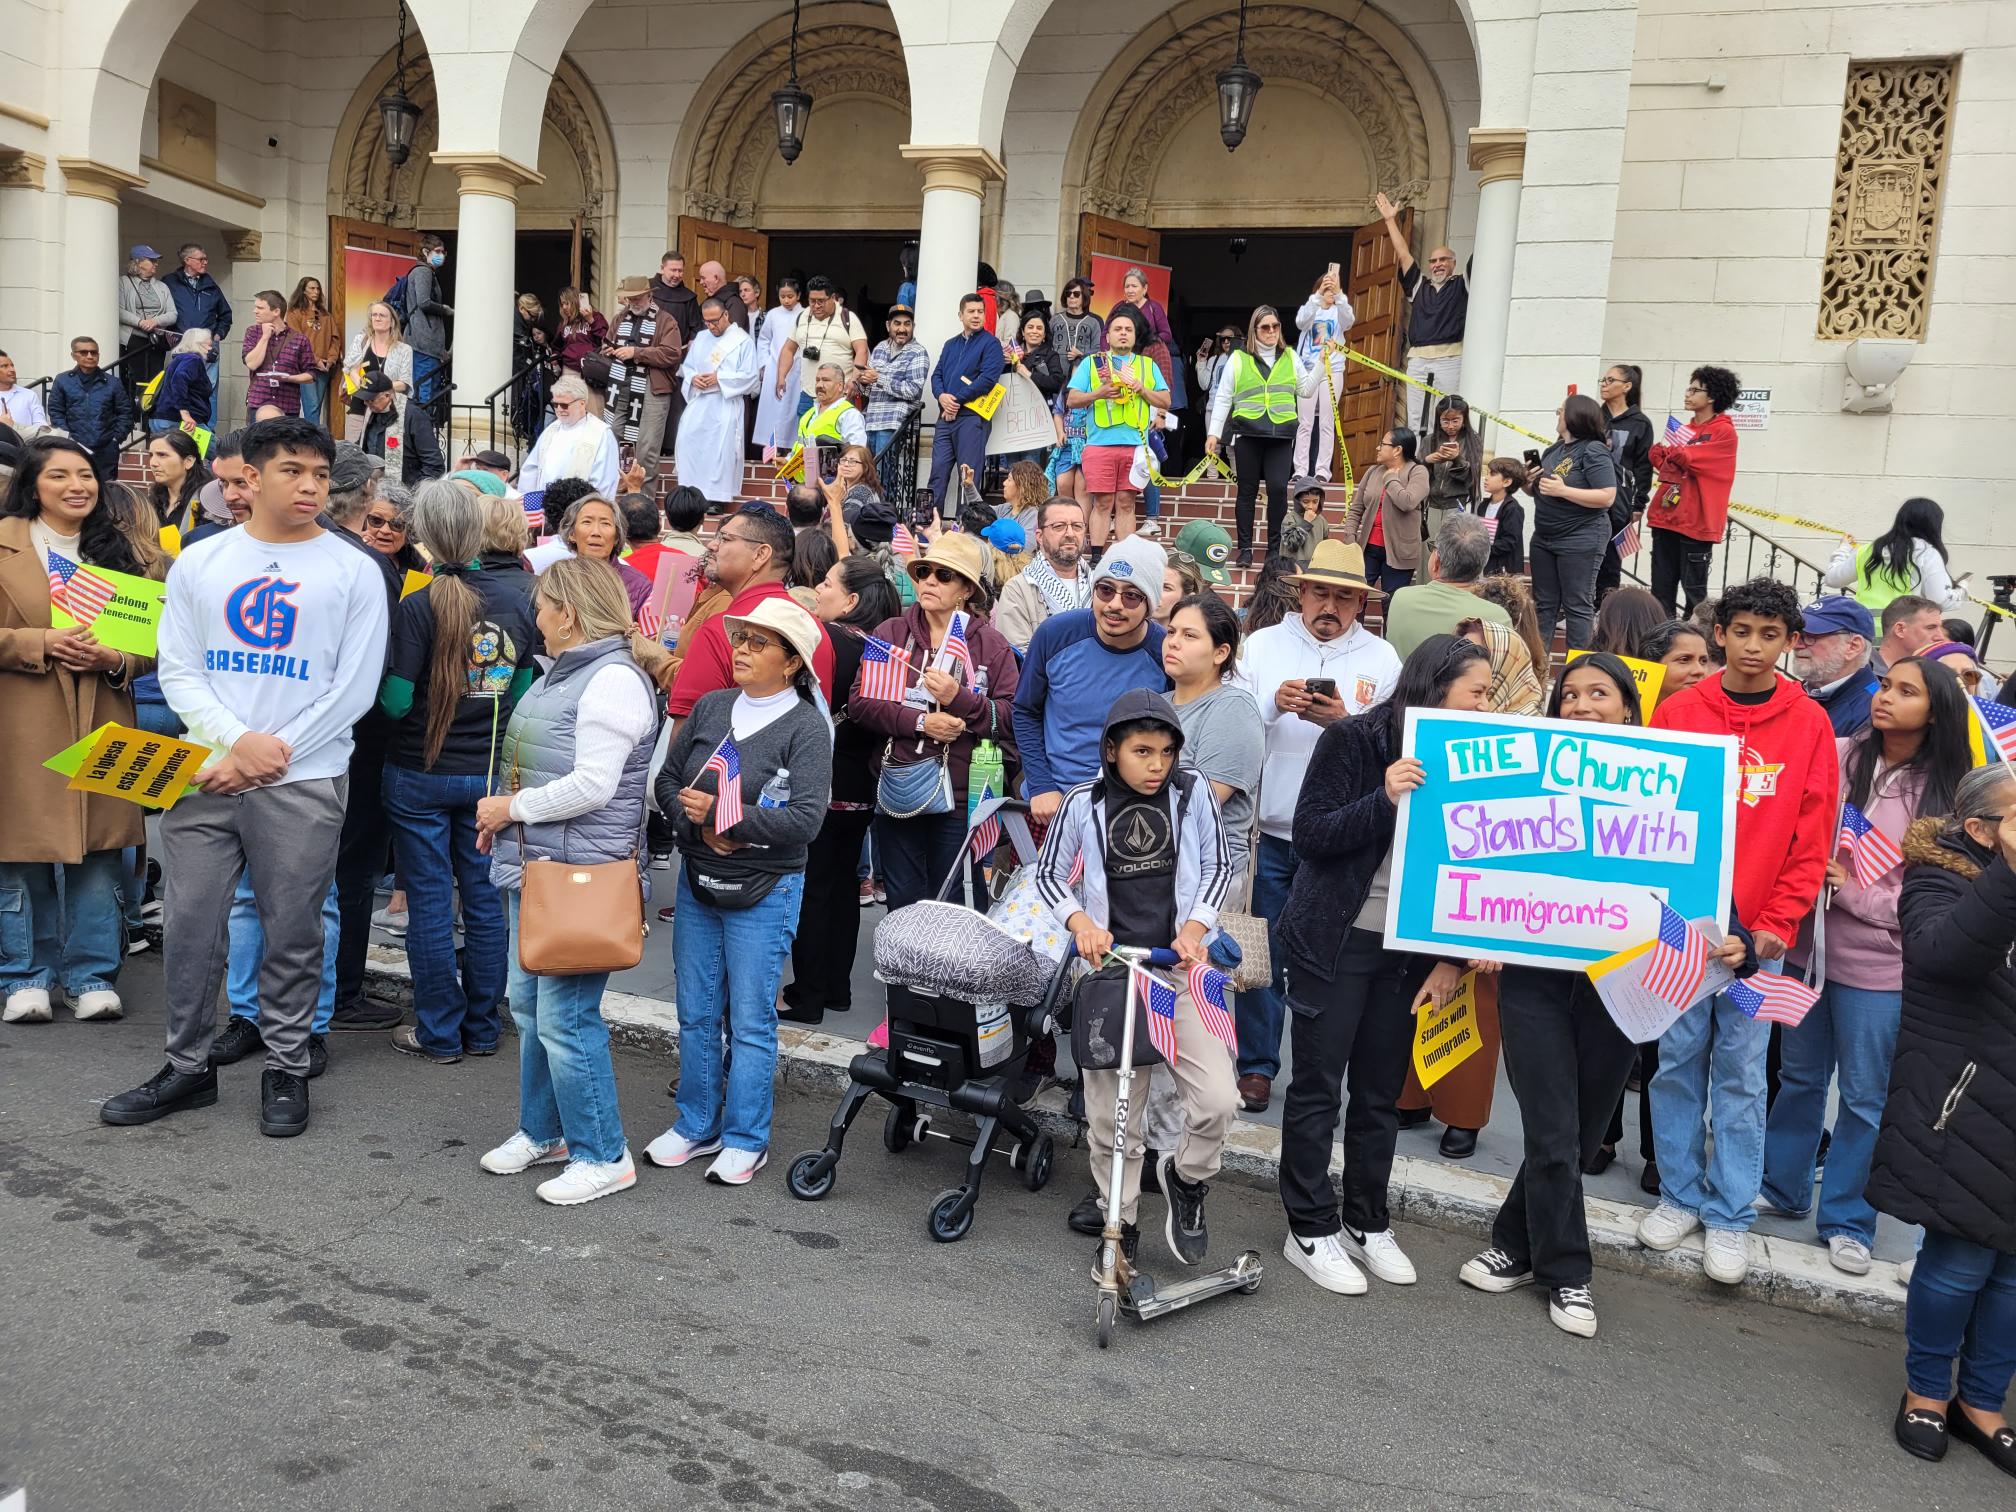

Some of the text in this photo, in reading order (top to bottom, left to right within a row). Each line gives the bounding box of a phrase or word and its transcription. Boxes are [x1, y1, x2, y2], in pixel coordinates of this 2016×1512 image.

[1739, 391, 1768, 400] OTICE
[103, 607, 152, 625] tenecemos
[111, 593, 149, 611] Belong
[206, 649, 310, 681] BASEBALL
[86, 740, 128, 780] La Iglesia
[116, 741, 161, 791] está con los
[141, 748, 191, 798] Inmigrantes
[1451, 737, 1679, 796] THE Church
[1450, 797, 1577, 859] Stands
[1113, 858, 1173, 874] VOLCOM
[1447, 871, 1629, 935] Immigrants
[1421, 1004, 1467, 1045] Stands with
[912, 1043, 935, 1054] evenflo
[1423, 1027, 1471, 1070] Immigrants
[1115, 1098, 1129, 1160] Razor
